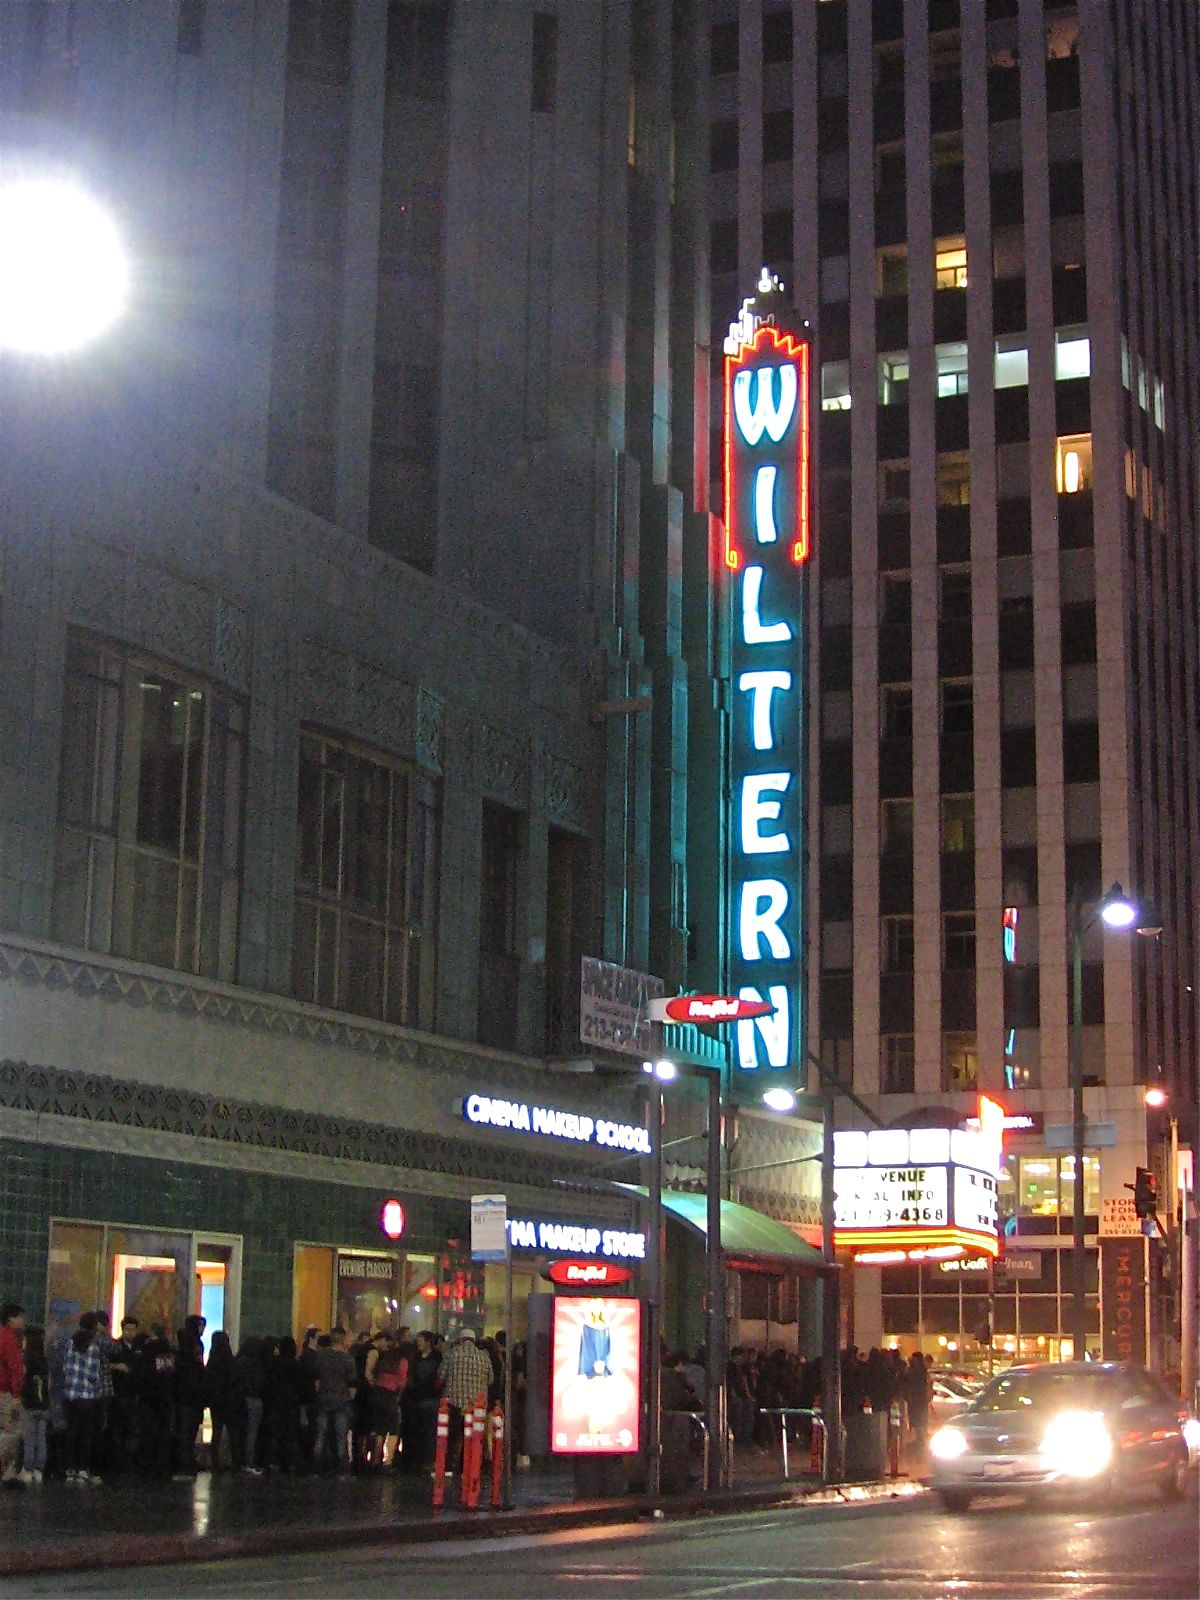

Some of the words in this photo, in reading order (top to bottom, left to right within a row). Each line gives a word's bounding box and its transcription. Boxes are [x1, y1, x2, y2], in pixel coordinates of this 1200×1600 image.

[733, 364, 797, 1069] WILTERN
[467, 1094, 531, 1131] CINEMA
[532, 1107, 594, 1142] MAKEUP
[596, 1120, 651, 1153] SCHOOL
[881, 1169, 926, 1183] VENUE
[901, 1190, 934, 1201] INFO
[1103, 1198, 1137, 1206] STOR
[1110, 1206, 1136, 1214] FOR
[539, 1222, 601, 1254] MAKEUP
[602, 1229, 646, 1259] STORE
